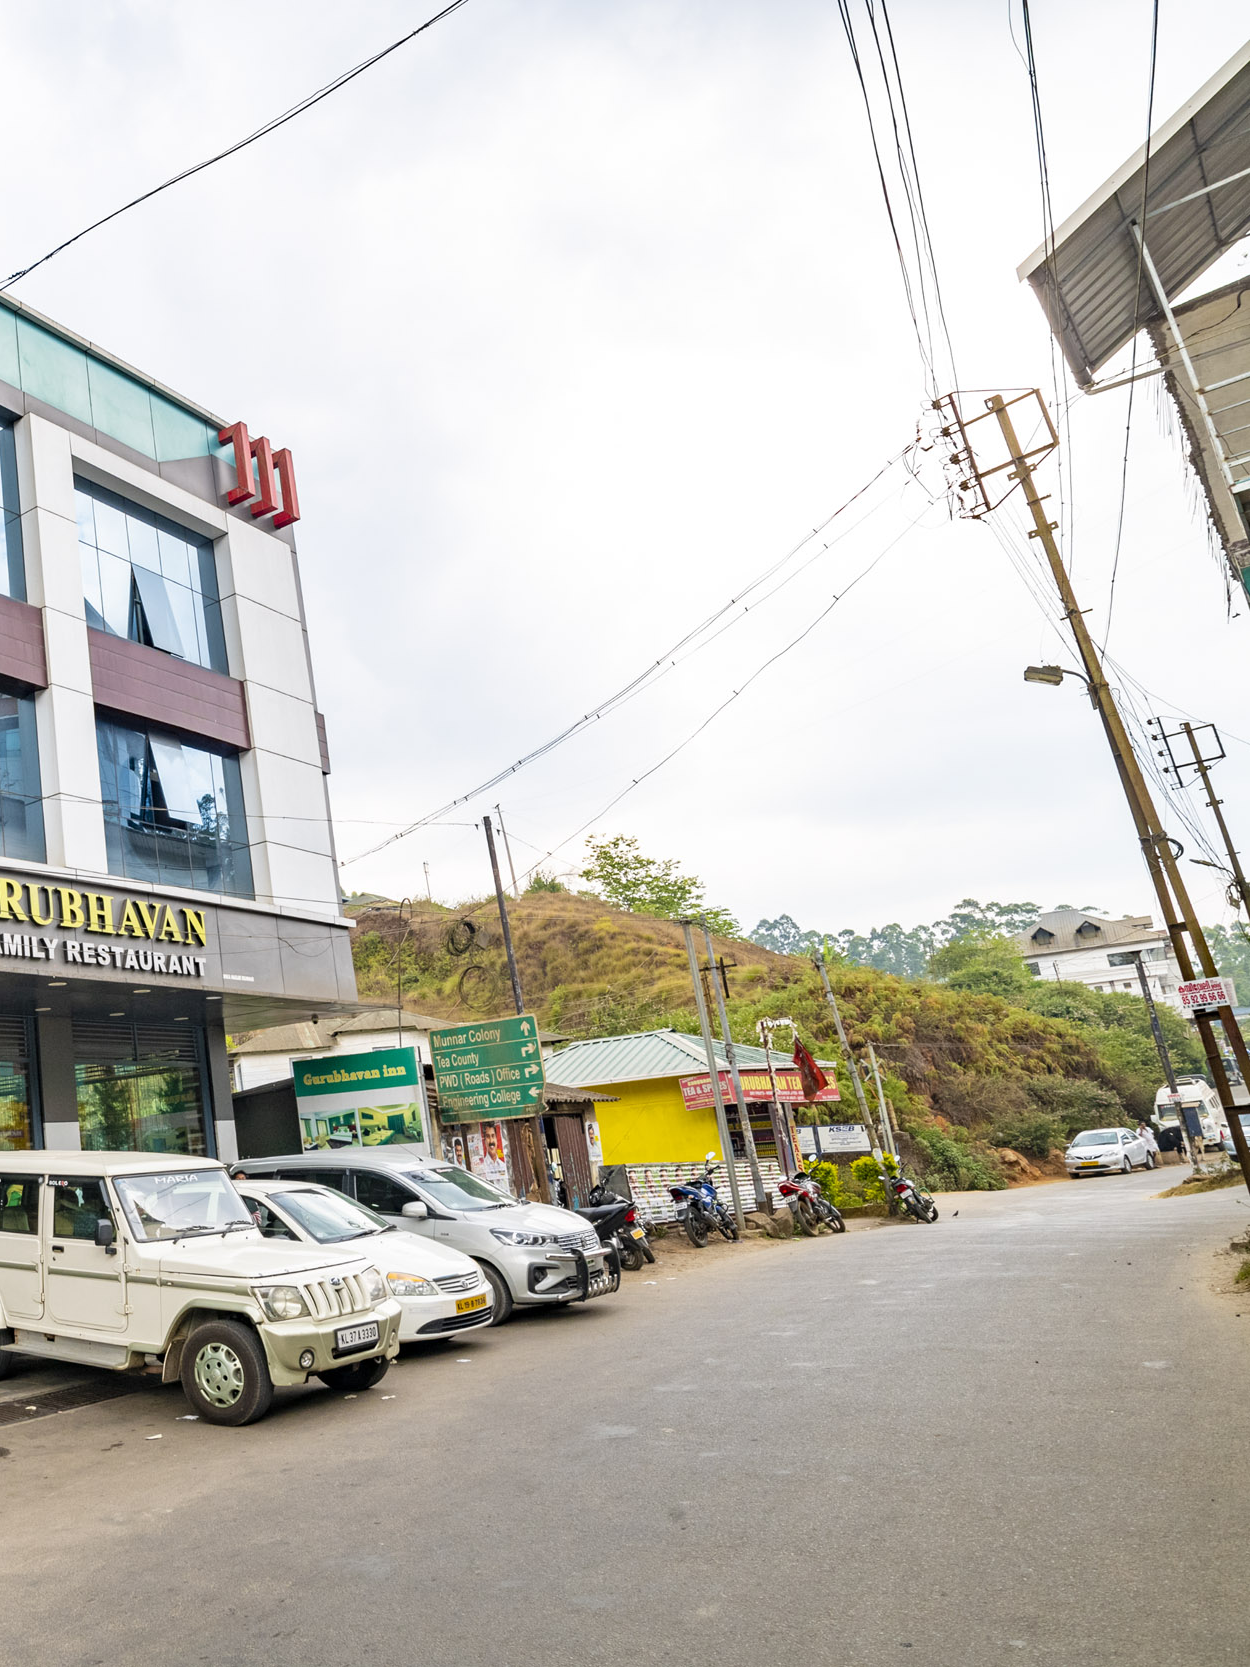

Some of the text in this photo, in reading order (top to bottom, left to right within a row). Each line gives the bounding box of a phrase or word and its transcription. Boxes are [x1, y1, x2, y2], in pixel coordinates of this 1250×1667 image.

[66, 940, 207, 977] RESTAURANT
[1181, 991, 1226, 1005] 85 92 99 66 66
[433, 1027, 501, 1048] Munnar Colony
[436, 1052, 479, 1069] Tea County
[303, 1064, 407, 1086] Gurubhavan inn
[439, 1074, 458, 1089] PWD
[464, 1071, 490, 1086] Roads
[496, 1067, 521, 1082] Office
[683, 1086, 696, 1096] TEA
[696, 1086, 703, 1094] &
[702, 1081, 727, 1093] SPES
[442, 1088, 521, 1110] Engineering College
[154, 1174, 198, 1184] MARIA
[341, 1333, 349, 1345] KL
[349, 1330, 357, 1342] 37
[362, 1326, 377, 1340] 3330
